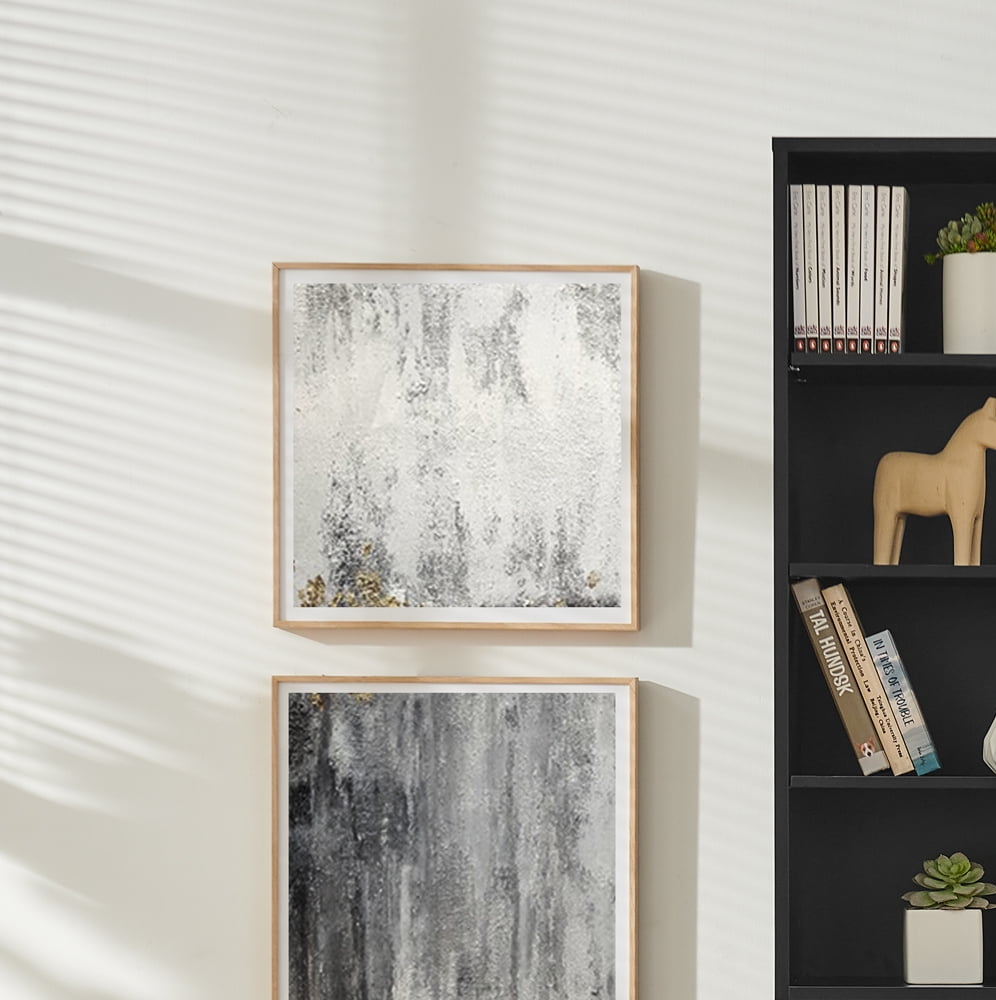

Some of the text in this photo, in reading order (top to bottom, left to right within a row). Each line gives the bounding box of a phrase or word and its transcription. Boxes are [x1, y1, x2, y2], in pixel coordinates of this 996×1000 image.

[808, 608, 854, 697] TAL HUNDSK
[830, 601, 872, 693] Environmental Protection Law
[840, 607, 854, 628] Course
[853, 639, 868, 662] China's
[872, 638, 915, 728] IN TIMES OF TROUBLE
[878, 719, 888, 734] China
[884, 718, 899, 743] University
[895, 744, 904, 758] Press
